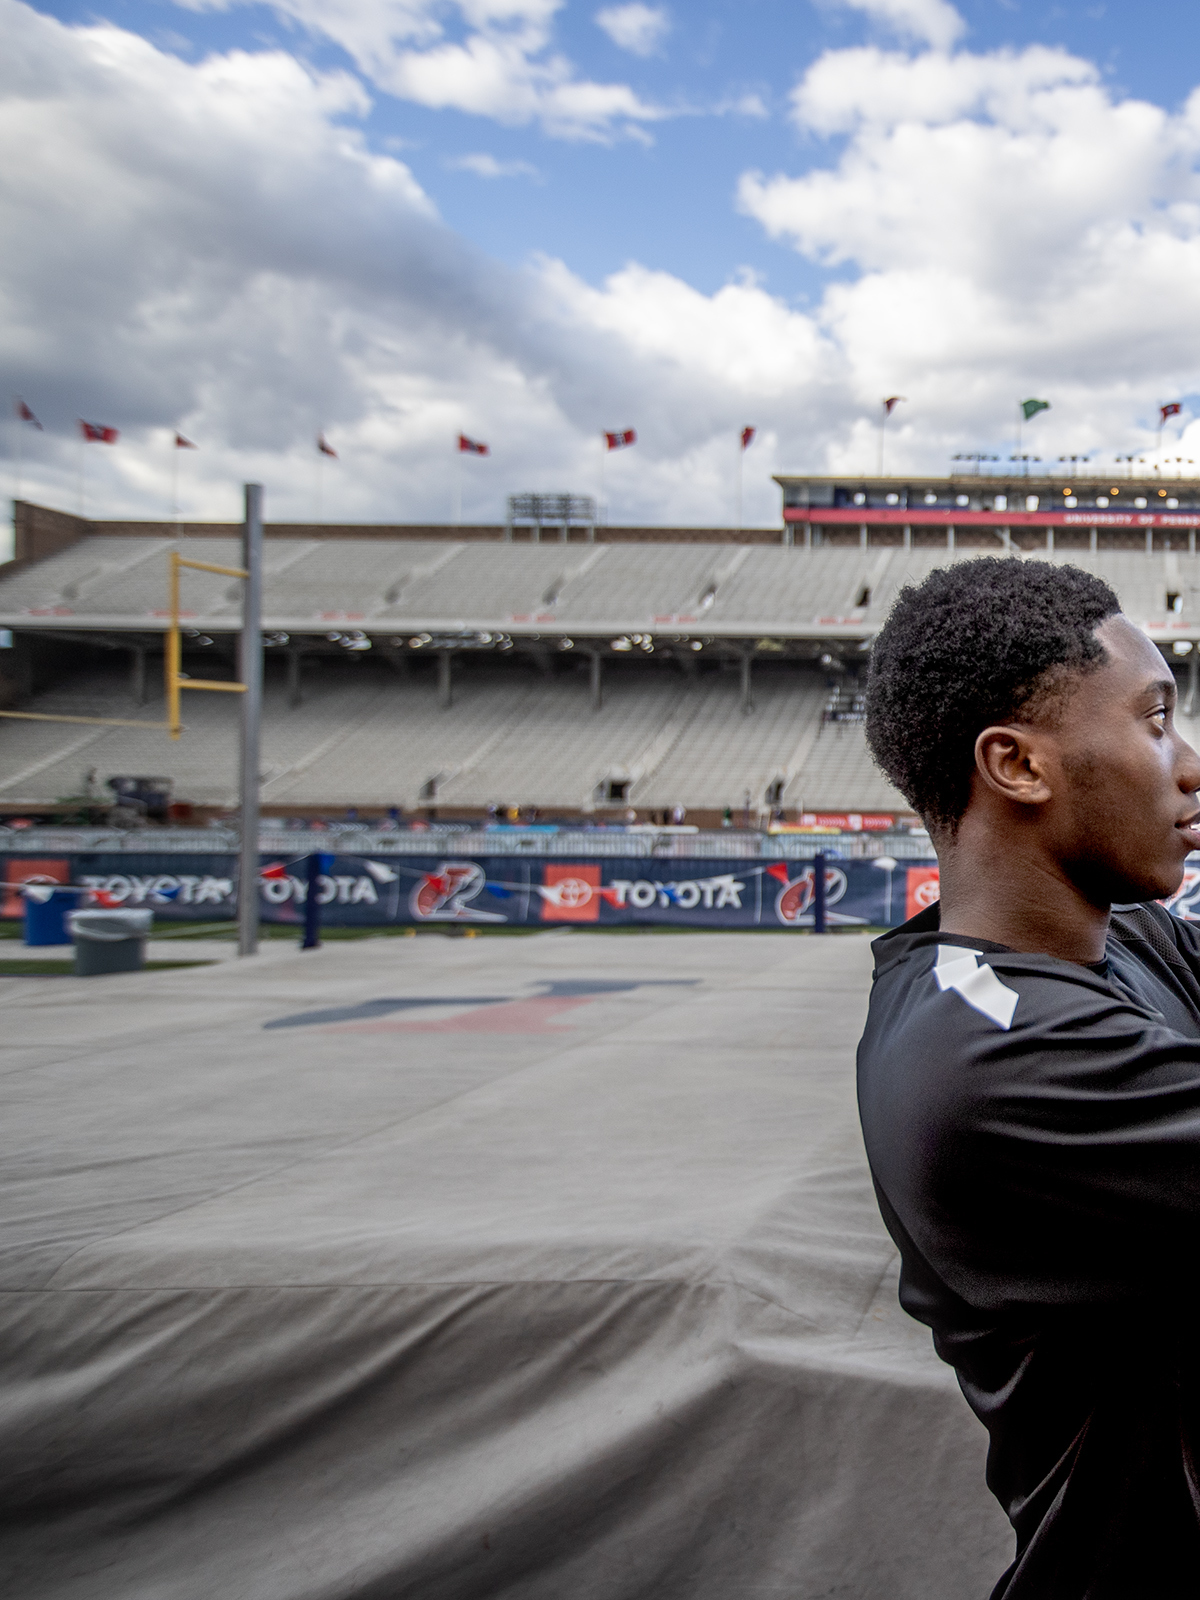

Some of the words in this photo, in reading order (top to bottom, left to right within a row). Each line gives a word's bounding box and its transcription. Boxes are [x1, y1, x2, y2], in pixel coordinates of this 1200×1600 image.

[1063, 513, 1133, 525] UNIVERSITY
[1137, 514, 1155, 526] OF
[611, 879, 743, 909] TOYOTA
